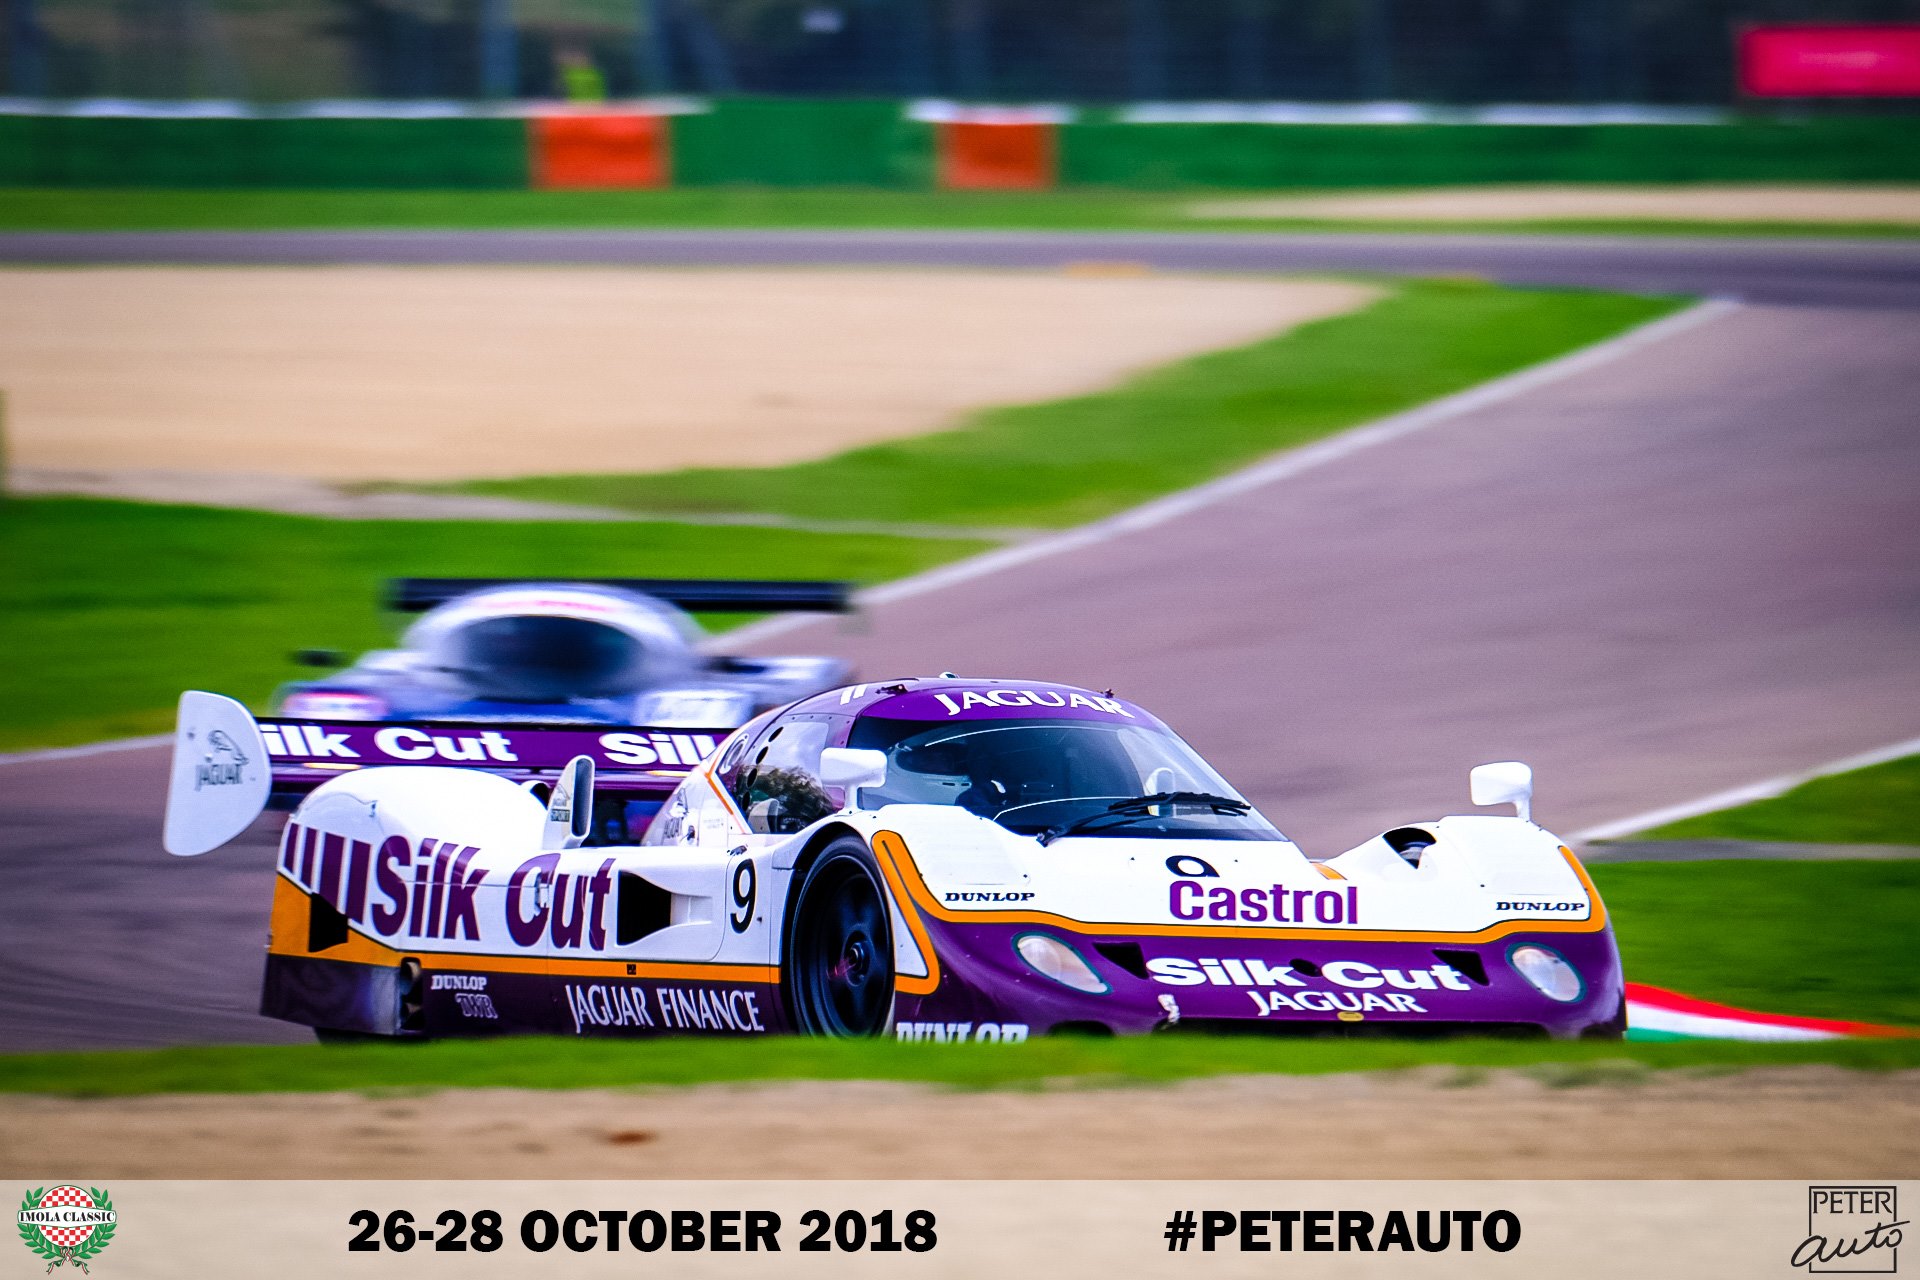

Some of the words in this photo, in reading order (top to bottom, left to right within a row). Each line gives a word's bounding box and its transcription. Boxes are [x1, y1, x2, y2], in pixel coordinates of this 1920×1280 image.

[933, 689, 1136, 719] JAGUAR
[260, 724, 361, 757] ilk
[374, 727, 518, 762] Cut
[598, 732, 716, 765] Sil
[371, 835, 490, 941] Silk
[505, 853, 616, 951] Cut
[730, 858, 756, 934] 9
[945, 892, 1035, 902] DUNLOP
[1169, 880, 1358, 924] Castrol
[1495, 902, 1585, 912] DUNLOP
[430, 974, 488, 991] DUNLOP
[1146, 957, 1308, 987] Silk
[1321, 960, 1471, 991] Cut
[565, 984, 655, 1034] JAGUAR
[656, 987, 765, 1032] FINANCE
[1247, 991, 1428, 1016] JAGUAR
